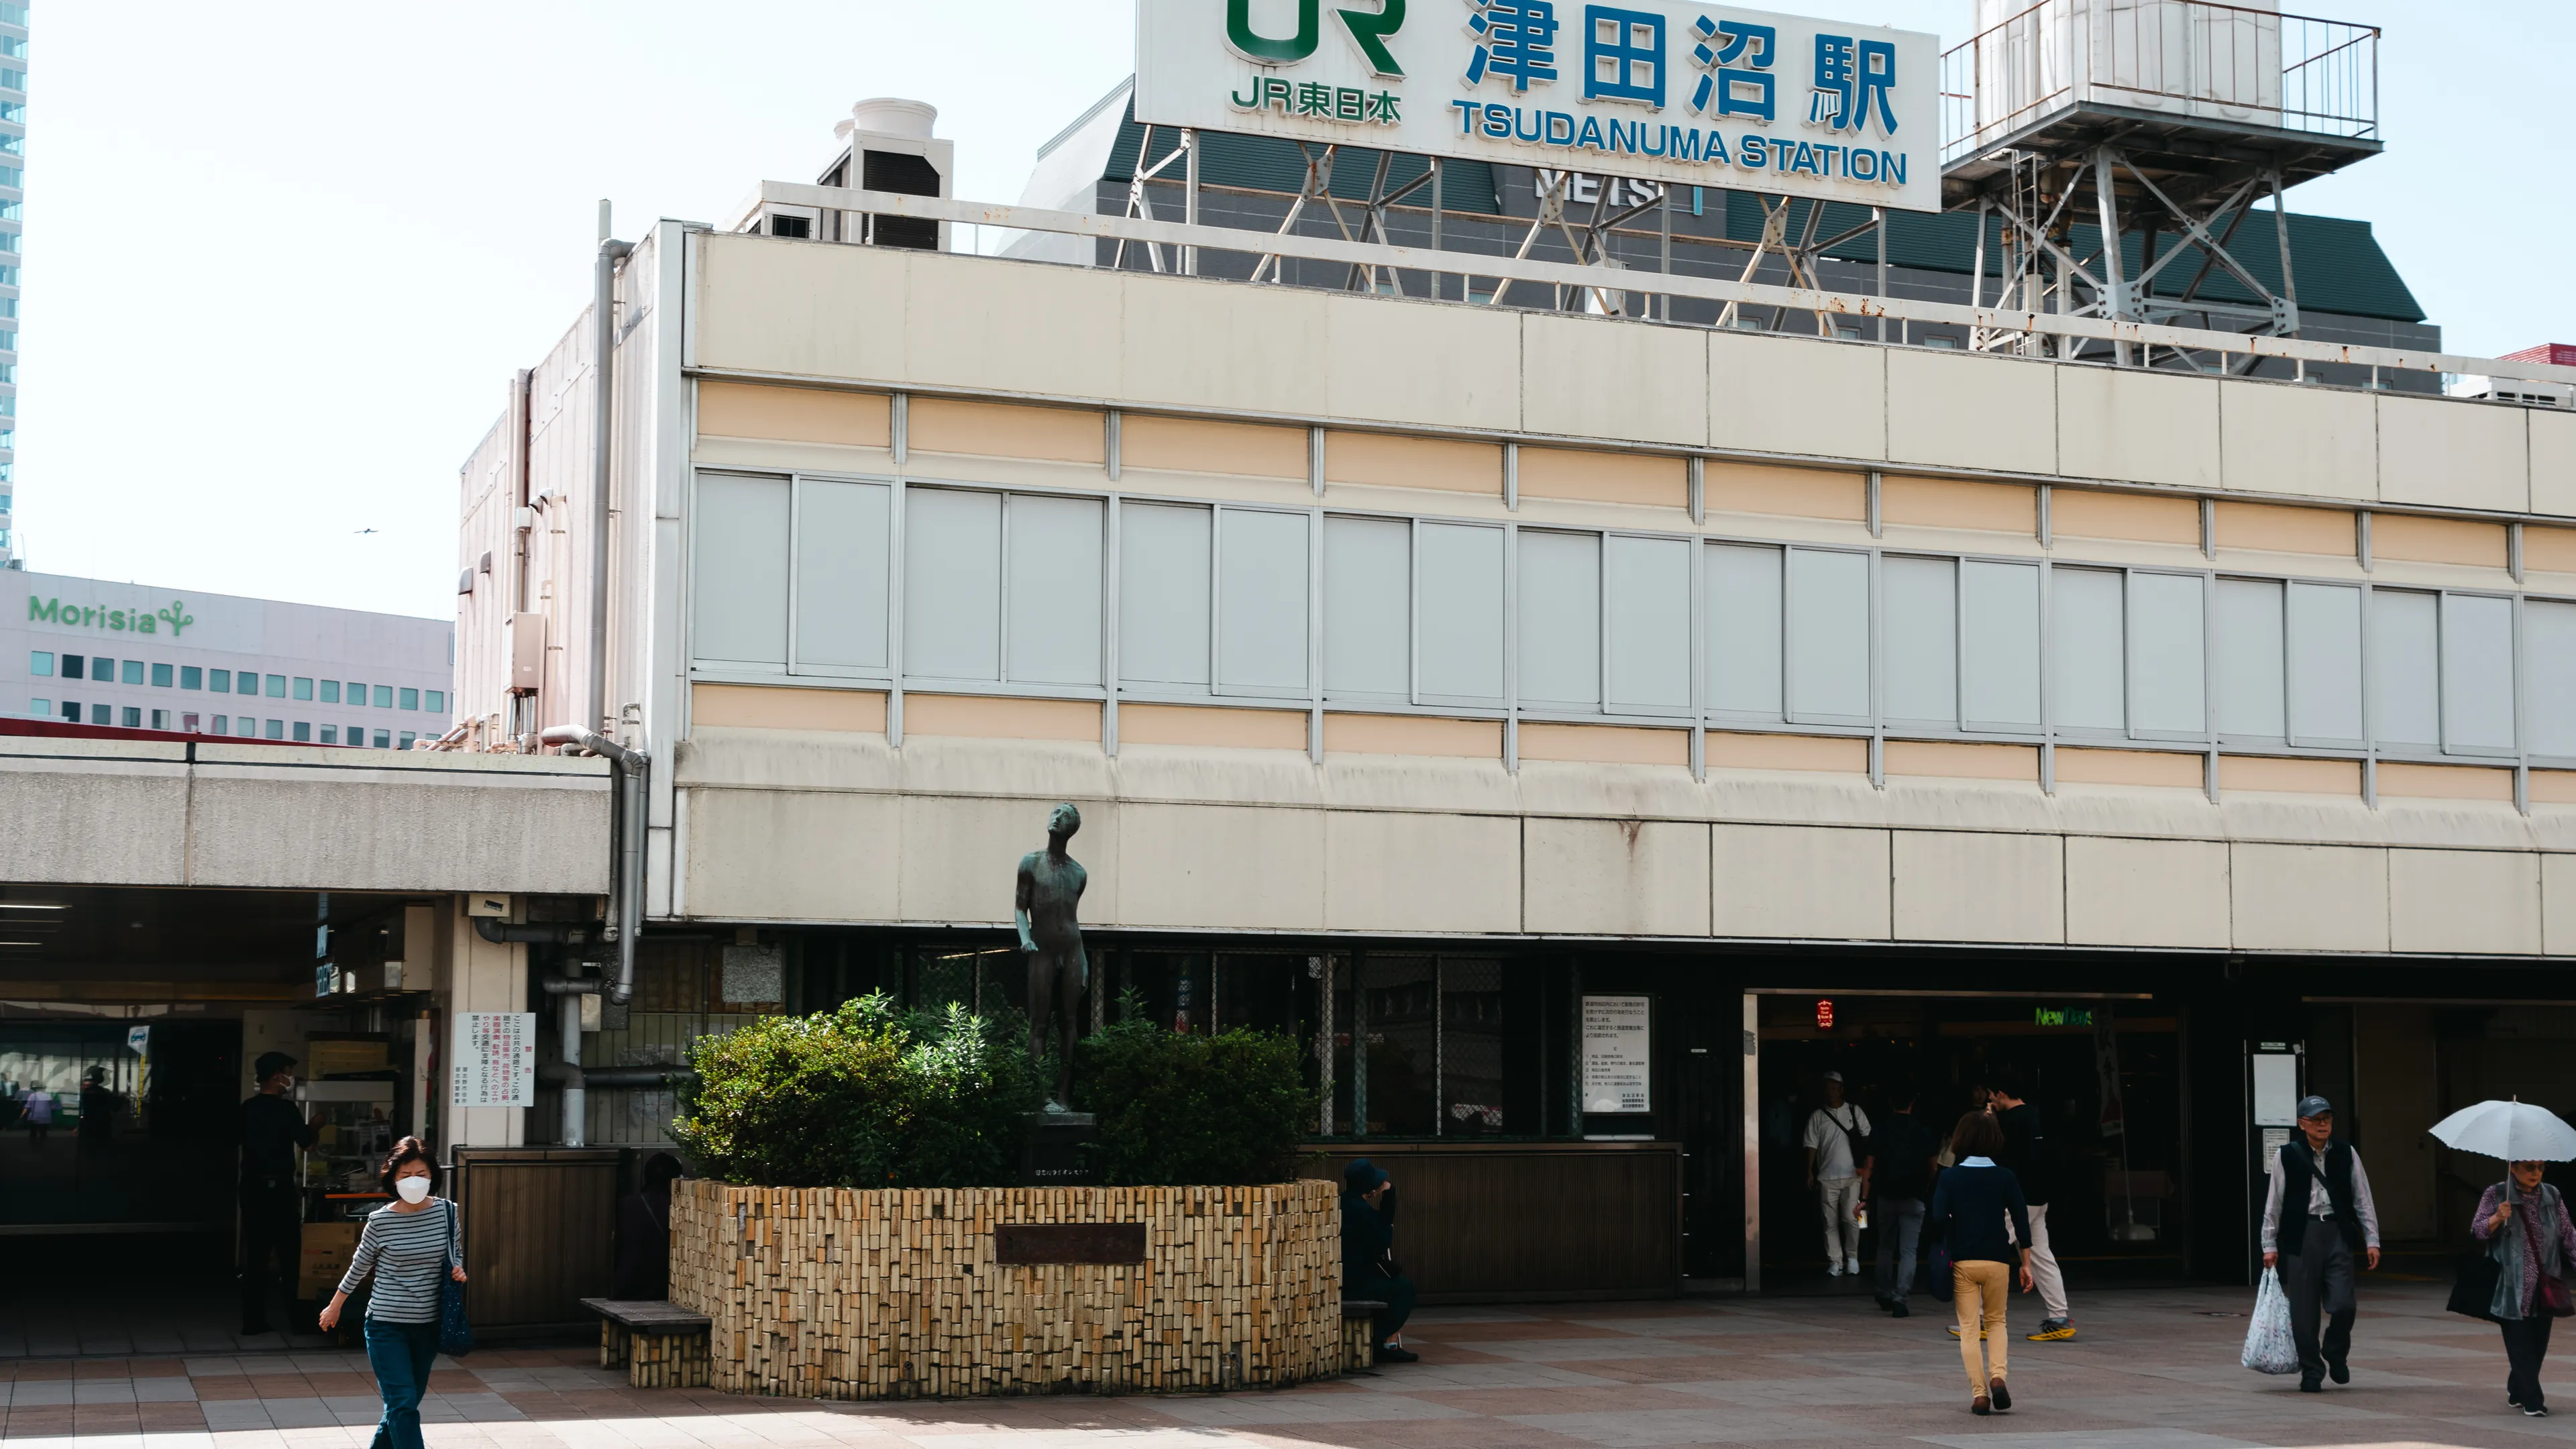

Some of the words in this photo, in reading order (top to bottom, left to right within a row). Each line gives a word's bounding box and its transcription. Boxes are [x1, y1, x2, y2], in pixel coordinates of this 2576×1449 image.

[1465, 0, 1898, 136] 津田沼駅
[1232, 75, 1402, 125] JR東日本
[1452, 99, 1731, 164] TSUDANUMA
[1740, 134, 1907, 185] STATION
[29, 595, 157, 634] Morisia
[471, 1015, 480, 1050] 禁止します。
